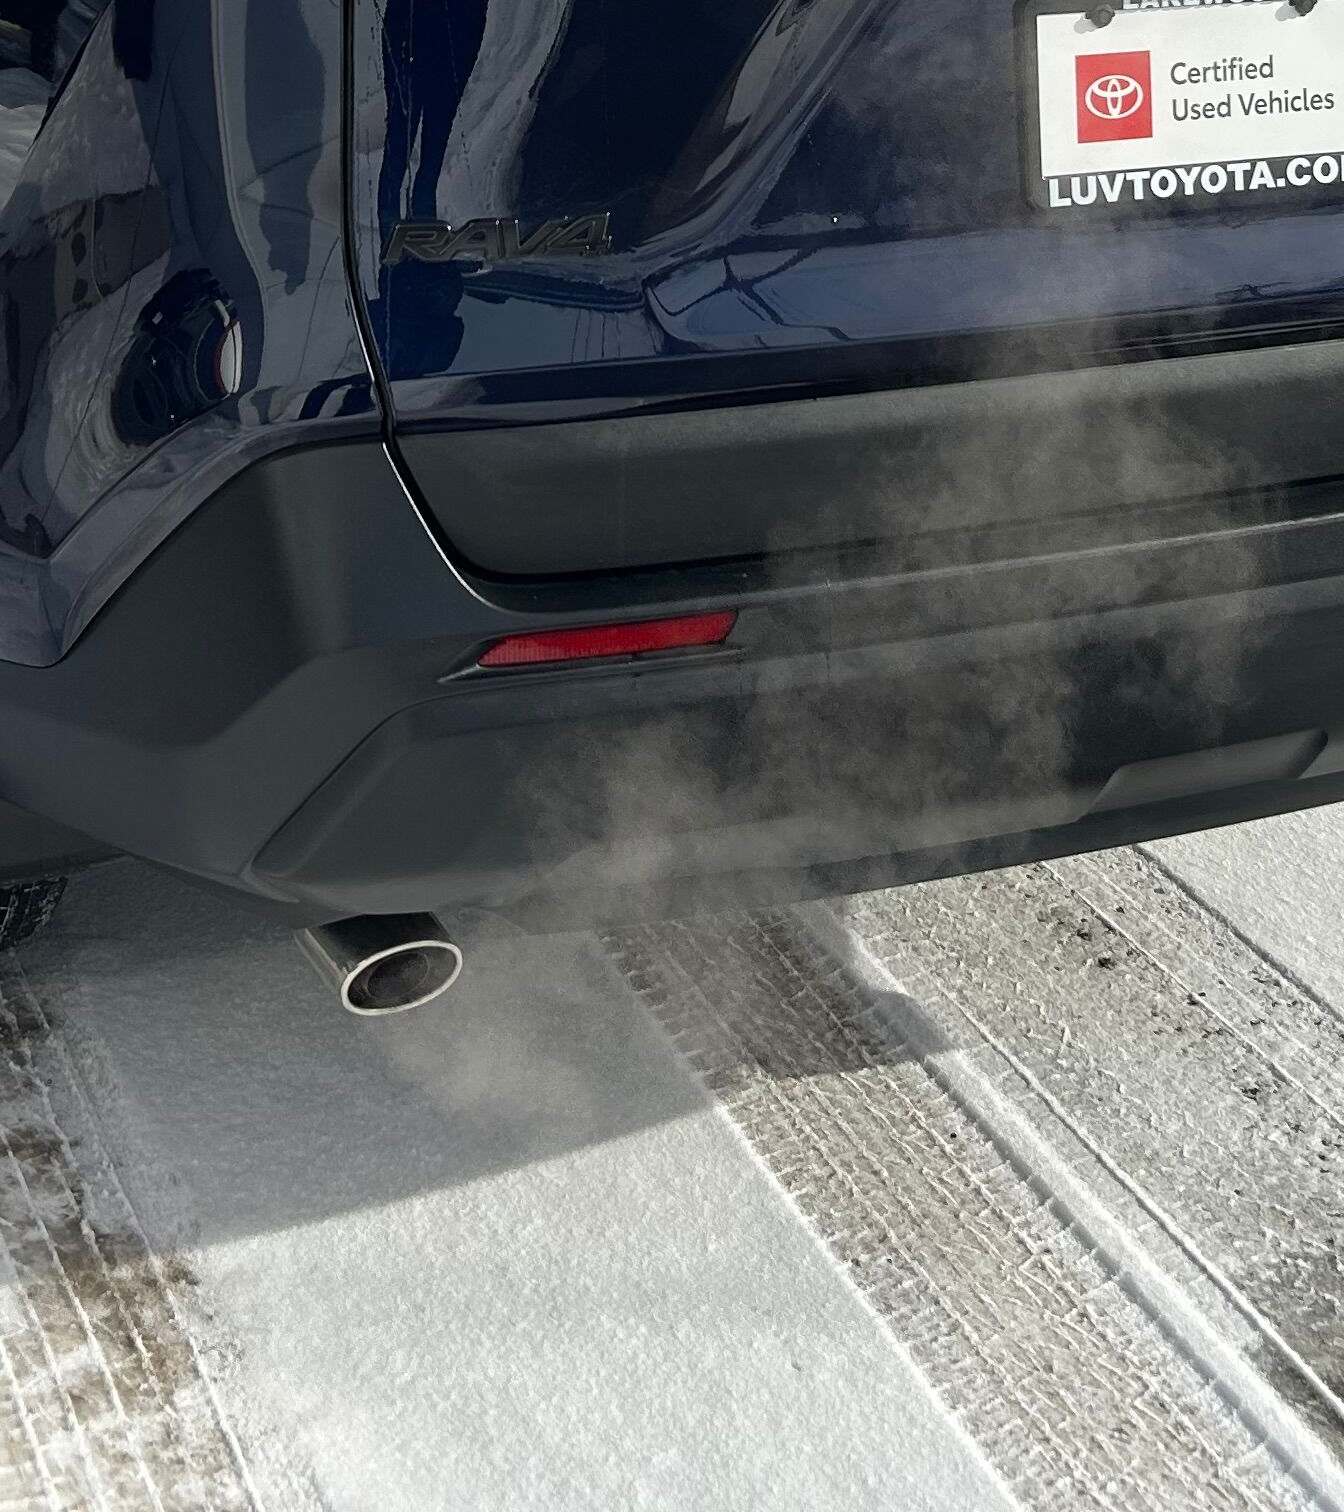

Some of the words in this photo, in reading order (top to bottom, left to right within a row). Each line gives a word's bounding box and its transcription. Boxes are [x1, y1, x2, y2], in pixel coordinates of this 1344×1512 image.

[1170, 55, 1274, 84] Certified
[1172, 94, 1231, 121] Used
[1238, 88, 1335, 115] Vehicles
[381, 212, 613, 264] RAV4
